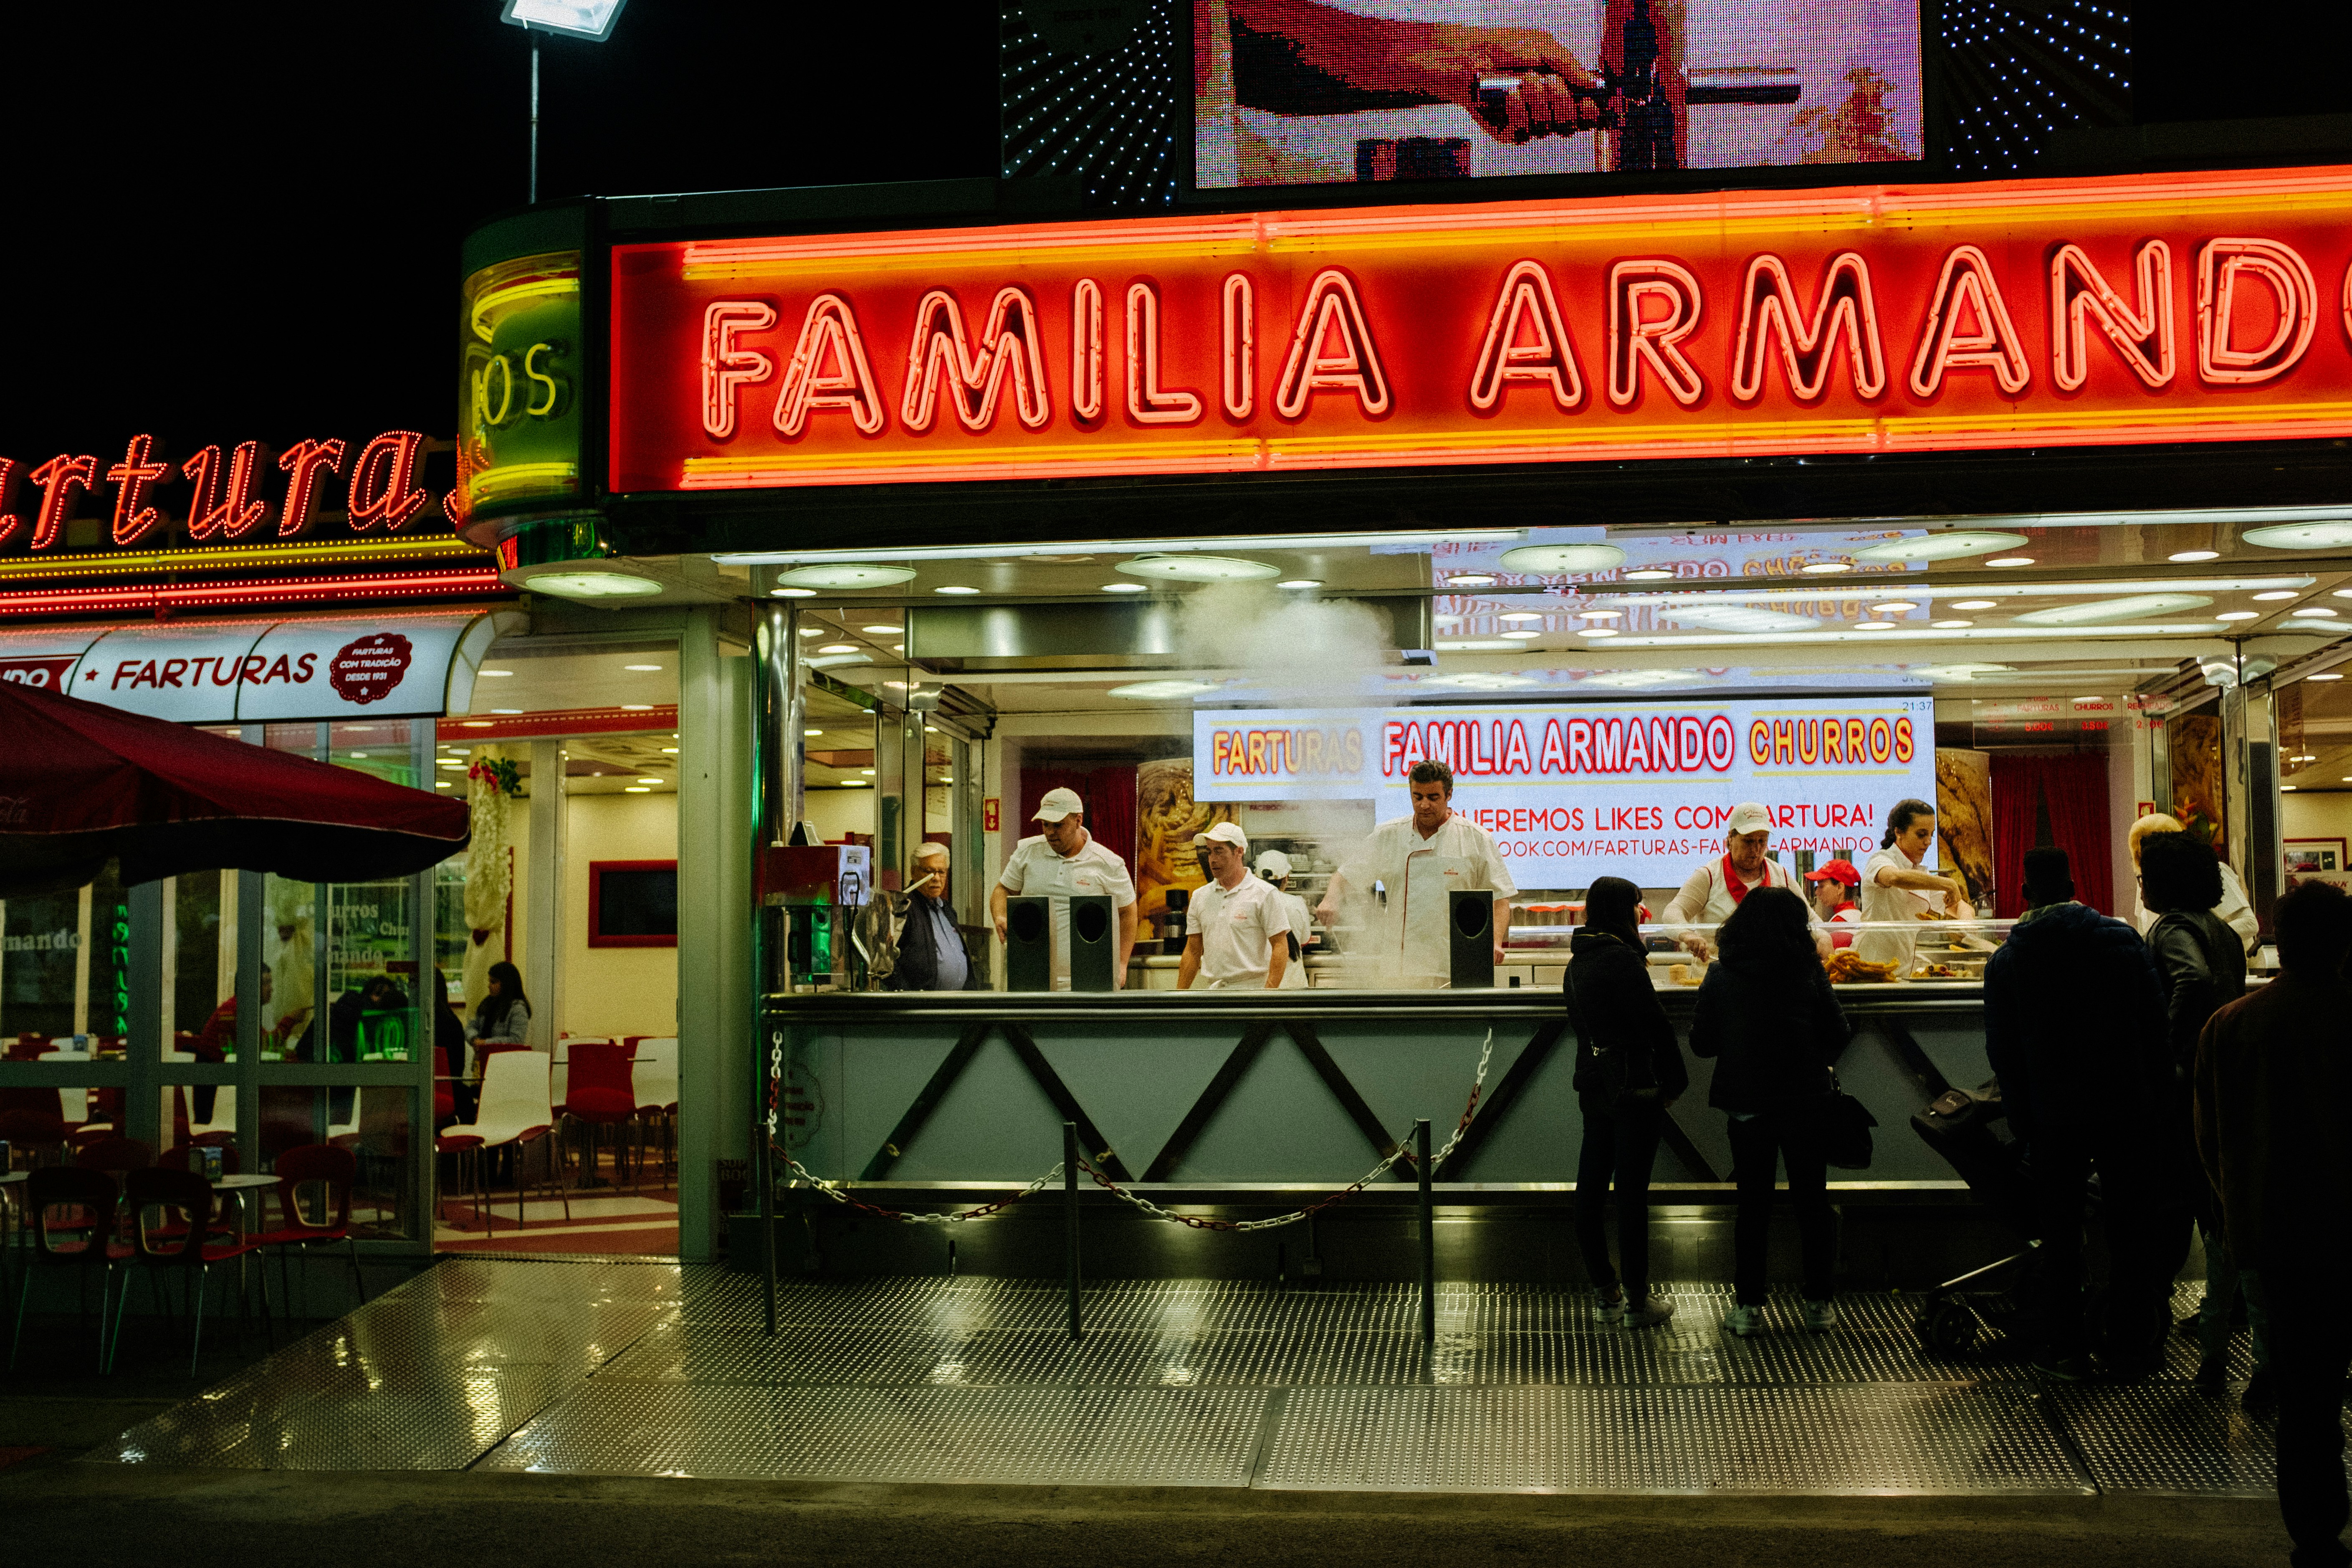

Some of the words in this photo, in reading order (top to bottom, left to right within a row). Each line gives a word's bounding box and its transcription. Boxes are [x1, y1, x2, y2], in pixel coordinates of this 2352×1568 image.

[701, 271, 1393, 438] FAMILIA
[1469, 238, 2352, 409] ARMAND
[0, 430, 462, 550] rtura
[352, 647, 394, 656] FARTURAS
[111, 652, 317, 691] FARTURAS
[339, 660, 359, 669] COM
[360, 657, 402, 668] TRADIÇÃO
[345, 673, 371, 682] DESDE
[372, 672, 388, 680] 1931
[1902, 701, 1932, 711] 21:37
[2074, 703, 2114, 711] CHURROS
[2136, 720, 2164, 729] 2.0€
[1213, 729, 1363, 775] FARTURAS
[1382, 719, 1532, 777] FAMILIA
[1540, 715, 1735, 775] ARMANDO
[1749, 717, 1914, 765] CHURROS
[1595, 806, 1663, 831] LIKES
[1766, 803, 1873, 829] ARTURA!
